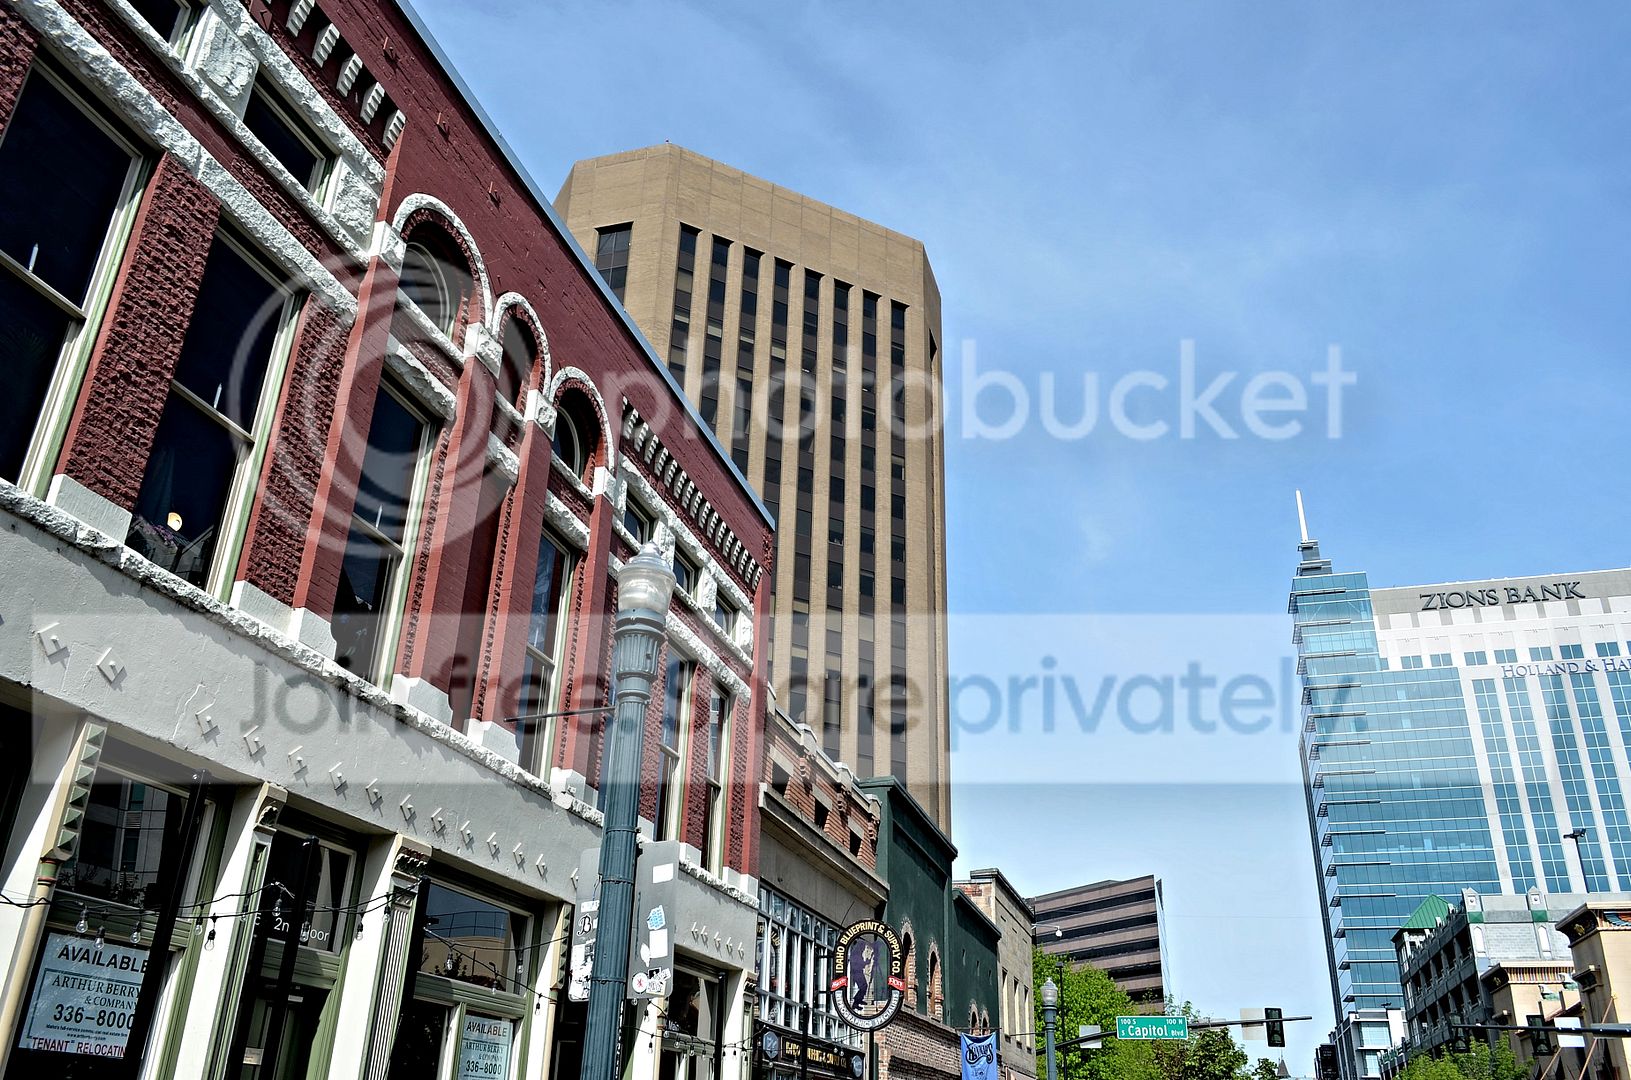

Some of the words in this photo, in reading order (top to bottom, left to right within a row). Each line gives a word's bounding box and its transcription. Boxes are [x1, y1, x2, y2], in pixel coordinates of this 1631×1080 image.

[1420, 588, 1499, 611] ZIONS
[1504, 581, 1586, 604] BANK
[1501, 660, 1580, 679] HOLLAND
[1585, 659, 1599, 672] &
[274, 917, 290, 933] 2n
[835, 946, 845, 974] IDAHO
[840, 921, 879, 945] BLUEPRINT
[877, 925, 885, 934] &
[884, 930, 901, 960] SUPPLY
[58, 944, 149, 974] AVAILABLE
[52, 974, 104, 994] ARTHUR
[106, 983, 141, 999] BERRY
[84, 996, 92, 1005] &
[53, 1004, 135, 1030] 336-8000
[466, 1021, 508, 1037] AVAILABLE
[1128, 1024, 1168, 1038] Capitol
[32, 1036, 70, 1052] TENANT
[76, 1041, 126, 1057] RELOCATIN
[465, 1041, 487, 1052] ARTHUR
[466, 1060, 502, 1075] 336-8000
